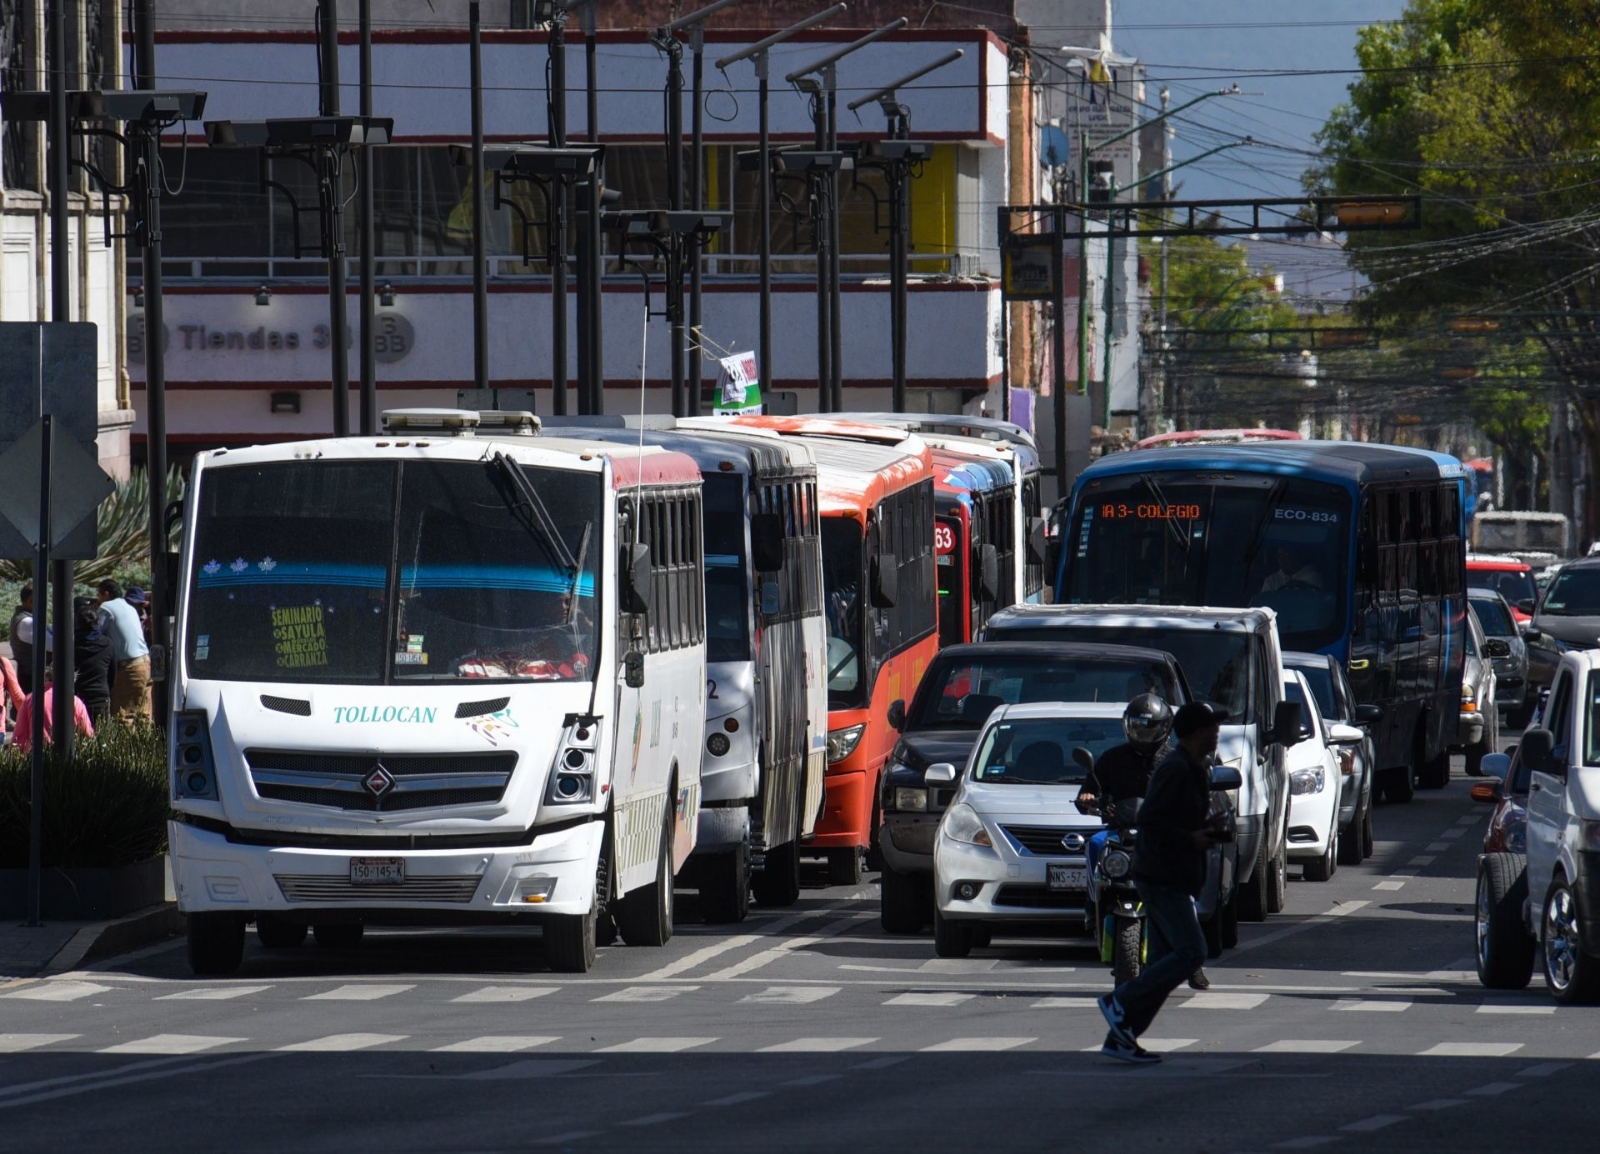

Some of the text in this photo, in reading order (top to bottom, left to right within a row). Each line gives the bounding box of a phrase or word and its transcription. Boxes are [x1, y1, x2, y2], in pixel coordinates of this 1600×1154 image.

[177, 324, 300, 350] Tiendas
[1137, 504, 1200, 518] COLEGIO
[1274, 508, 1338, 523] ECO-834
[935, 527, 952, 548] 63
[271, 606, 322, 627] SEMINARIO
[281, 622, 325, 640] SAYULA
[283, 638, 326, 654] MERCADO
[284, 651, 328, 668] CARRANZA
[707, 678, 719, 700] 2
[333, 705, 438, 724] TOLLOCAN
